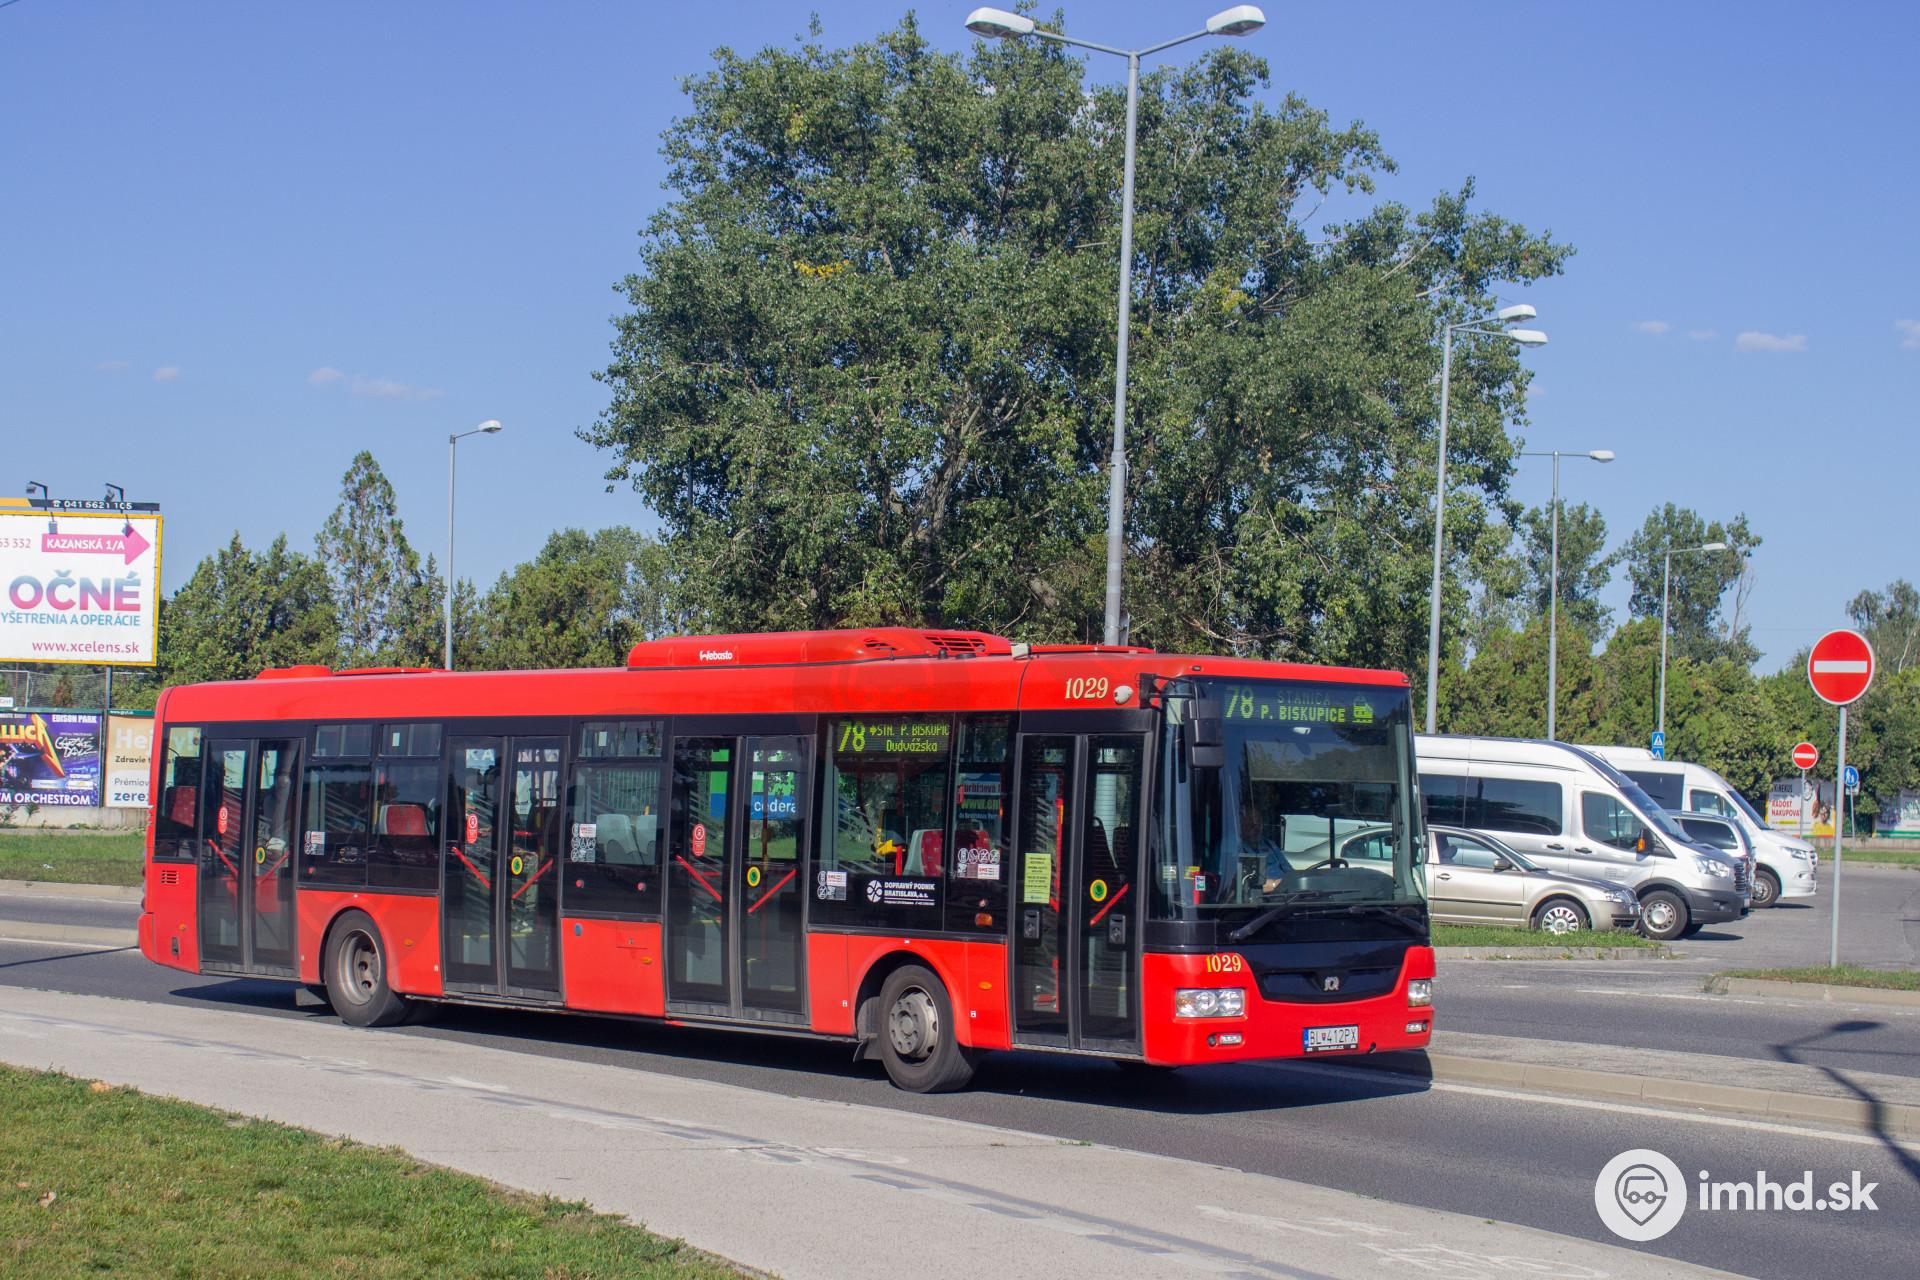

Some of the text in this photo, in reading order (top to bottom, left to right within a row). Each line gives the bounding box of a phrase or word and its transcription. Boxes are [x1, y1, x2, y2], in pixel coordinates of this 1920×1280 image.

[64, 500, 82, 508] 041
[13, 538, 31, 549] 332
[46, 537, 125, 550] KAZANSKÁ 1/A
[9, 569, 141, 612] OČNÉ
[70, 614, 78, 625] A
[80, 613, 141, 626] OPERÁCIE
[32, 641, 139, 654] www.xcelens.sk
[1065, 677, 1109, 699] 1029
[1225, 685, 1346, 723] 78 P. BISKUPICE
[838, 720, 866, 752] 78
[886, 737, 938, 752] Dudvážska
[115, 755, 146, 763] Zdravie
[0, 791, 91, 805] M ORCHESTROM
[114, 792, 151, 802] zere
[1771, 809, 1802, 817] NAKUPOVA
[884, 881, 913, 889] DOPRAVNÝ
[1206, 954, 1242, 973] 1029
